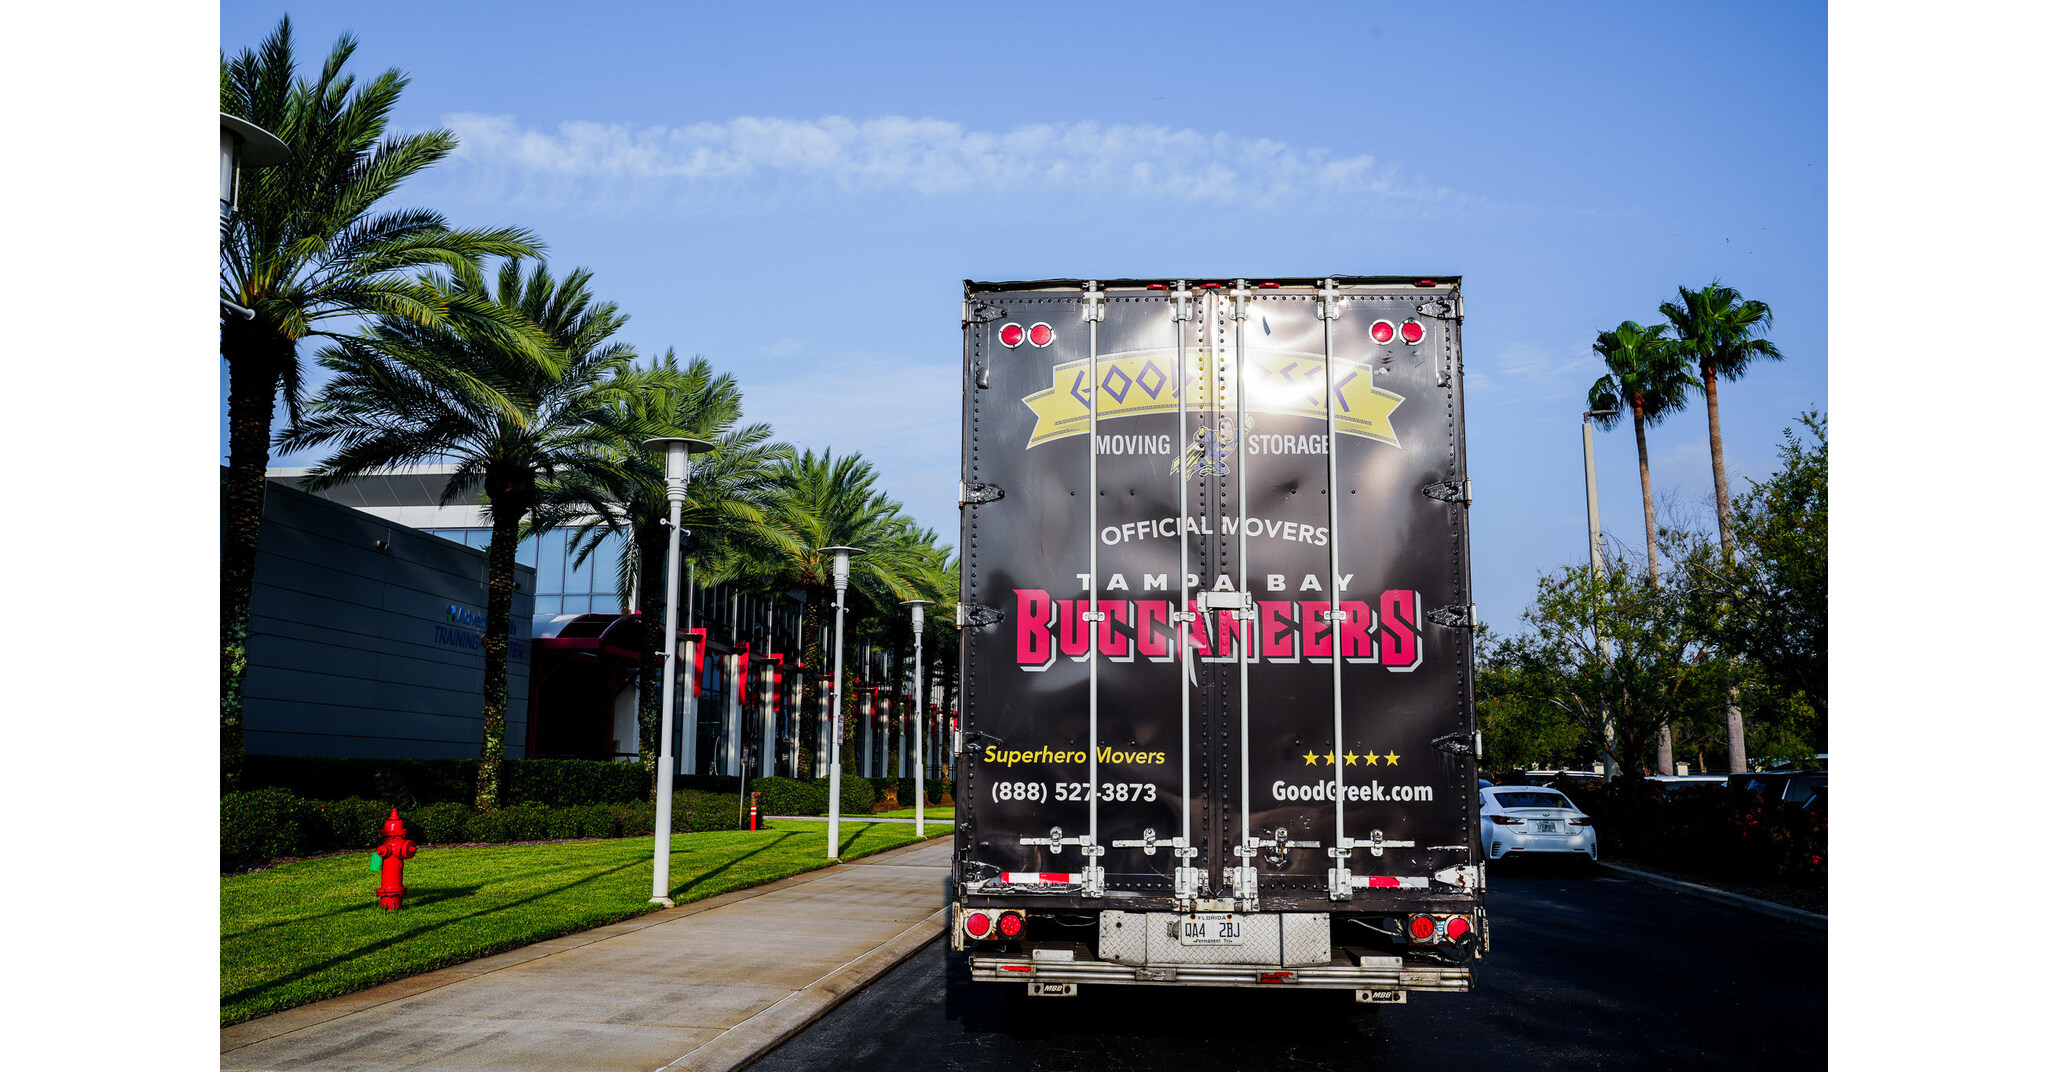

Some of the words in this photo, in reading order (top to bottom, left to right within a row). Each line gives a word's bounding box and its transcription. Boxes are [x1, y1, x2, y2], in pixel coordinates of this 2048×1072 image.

[1096, 434, 1171, 455] MOVING
[1248, 434, 1329, 455] STORAGE
[1100, 516, 1214, 546] OFFICIAL
[1222, 516, 1329, 546] MOVERS
[1076, 573, 1236, 591] TAMPA
[1267, 573, 1354, 591] BAY
[434, 625, 480, 650] TRAINING
[1013, 589, 1423, 672] BUCCANEERS
[983, 745, 1087, 767] Superhero
[1096, 746, 1166, 764] Movers
[992, 781, 1048, 804] (888)
[1054, 782, 1157, 802] 527-3873
[1272, 779, 1433, 801] GoodGreek.com
[1185, 922, 1206, 937] QA4
[1219, 922, 1240, 937] 2BJ
[1372, 991, 1392, 999] MBB
